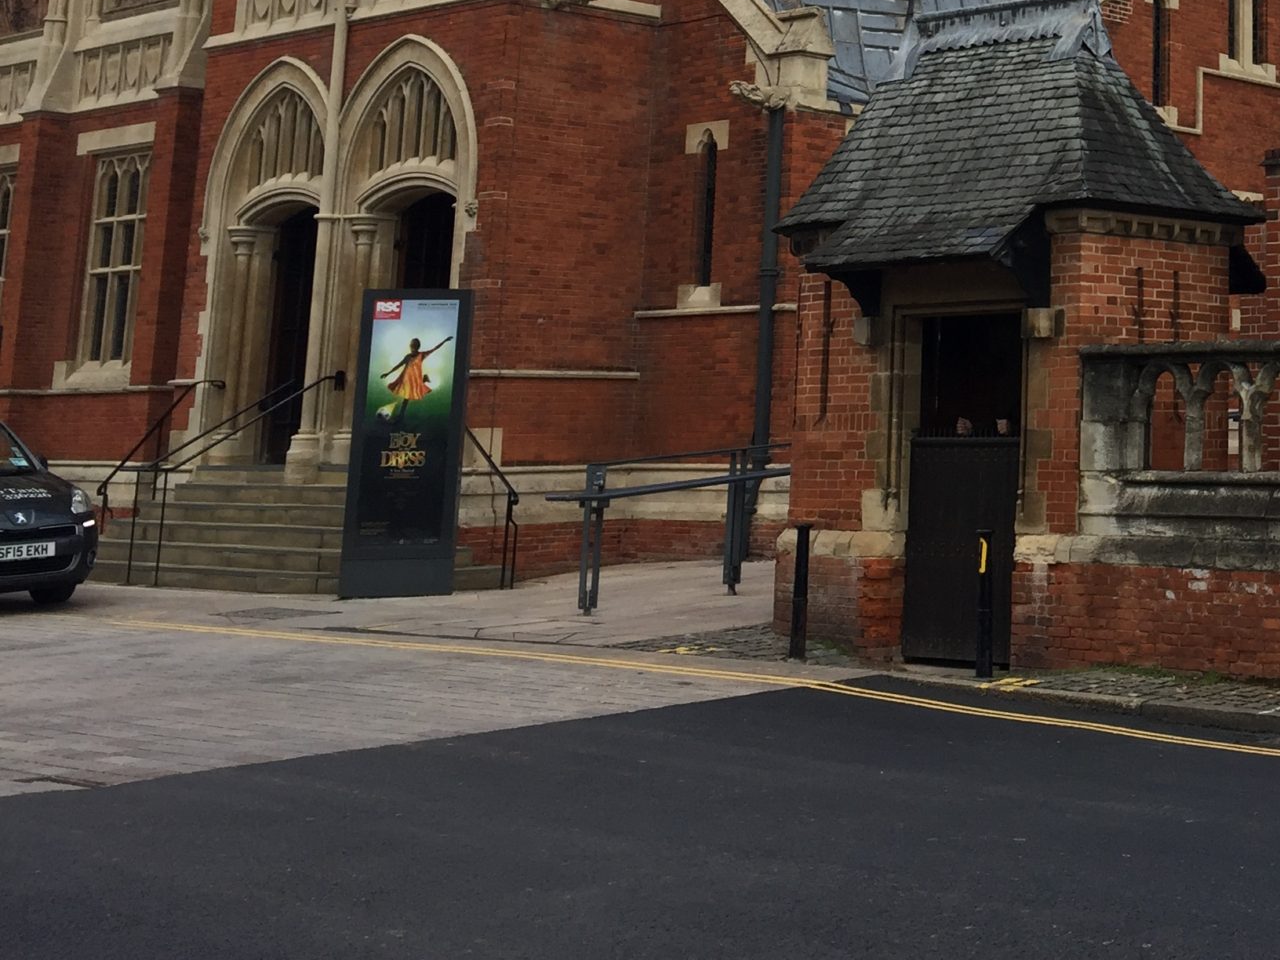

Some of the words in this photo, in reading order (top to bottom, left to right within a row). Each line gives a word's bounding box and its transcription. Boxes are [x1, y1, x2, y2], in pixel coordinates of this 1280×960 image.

[376, 301, 400, 312] RSC
[389, 432, 421, 449] BOY
[380, 451, 426, 468] DRESS
[0, 545, 23, 559] SF15
[26, 544, 48, 556] EKH
